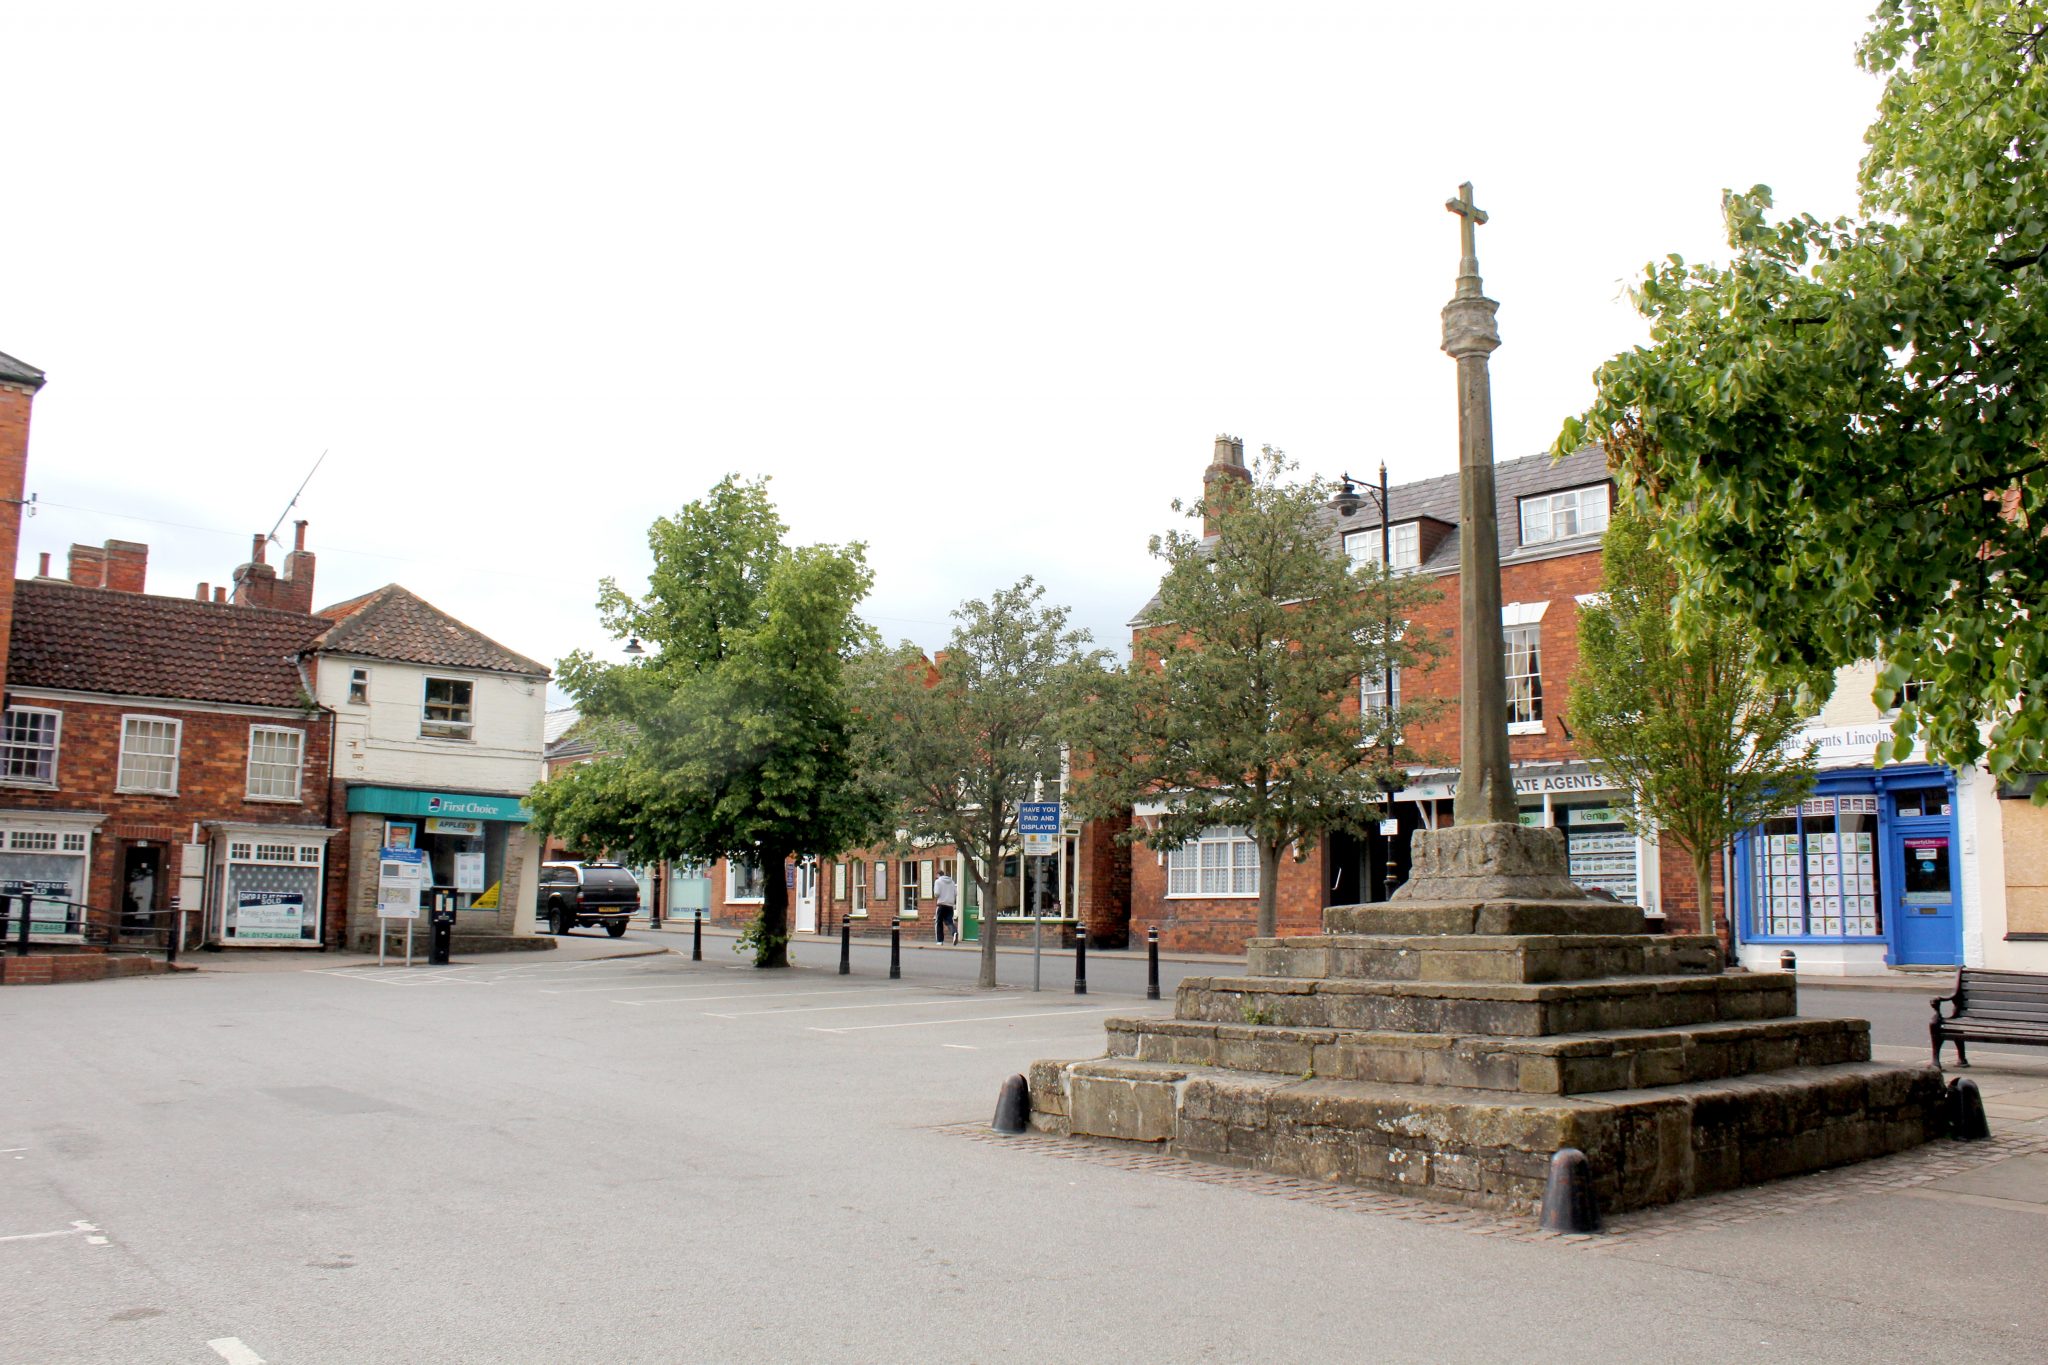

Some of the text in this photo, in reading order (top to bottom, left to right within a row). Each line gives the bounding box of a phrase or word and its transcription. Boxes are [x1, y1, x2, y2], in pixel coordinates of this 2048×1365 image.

[1514, 773, 1602, 792] ATE AGENTS
[443, 800, 465, 812] First
[466, 802, 498, 814] Choice
[1580, 810, 1609, 824] kemp
